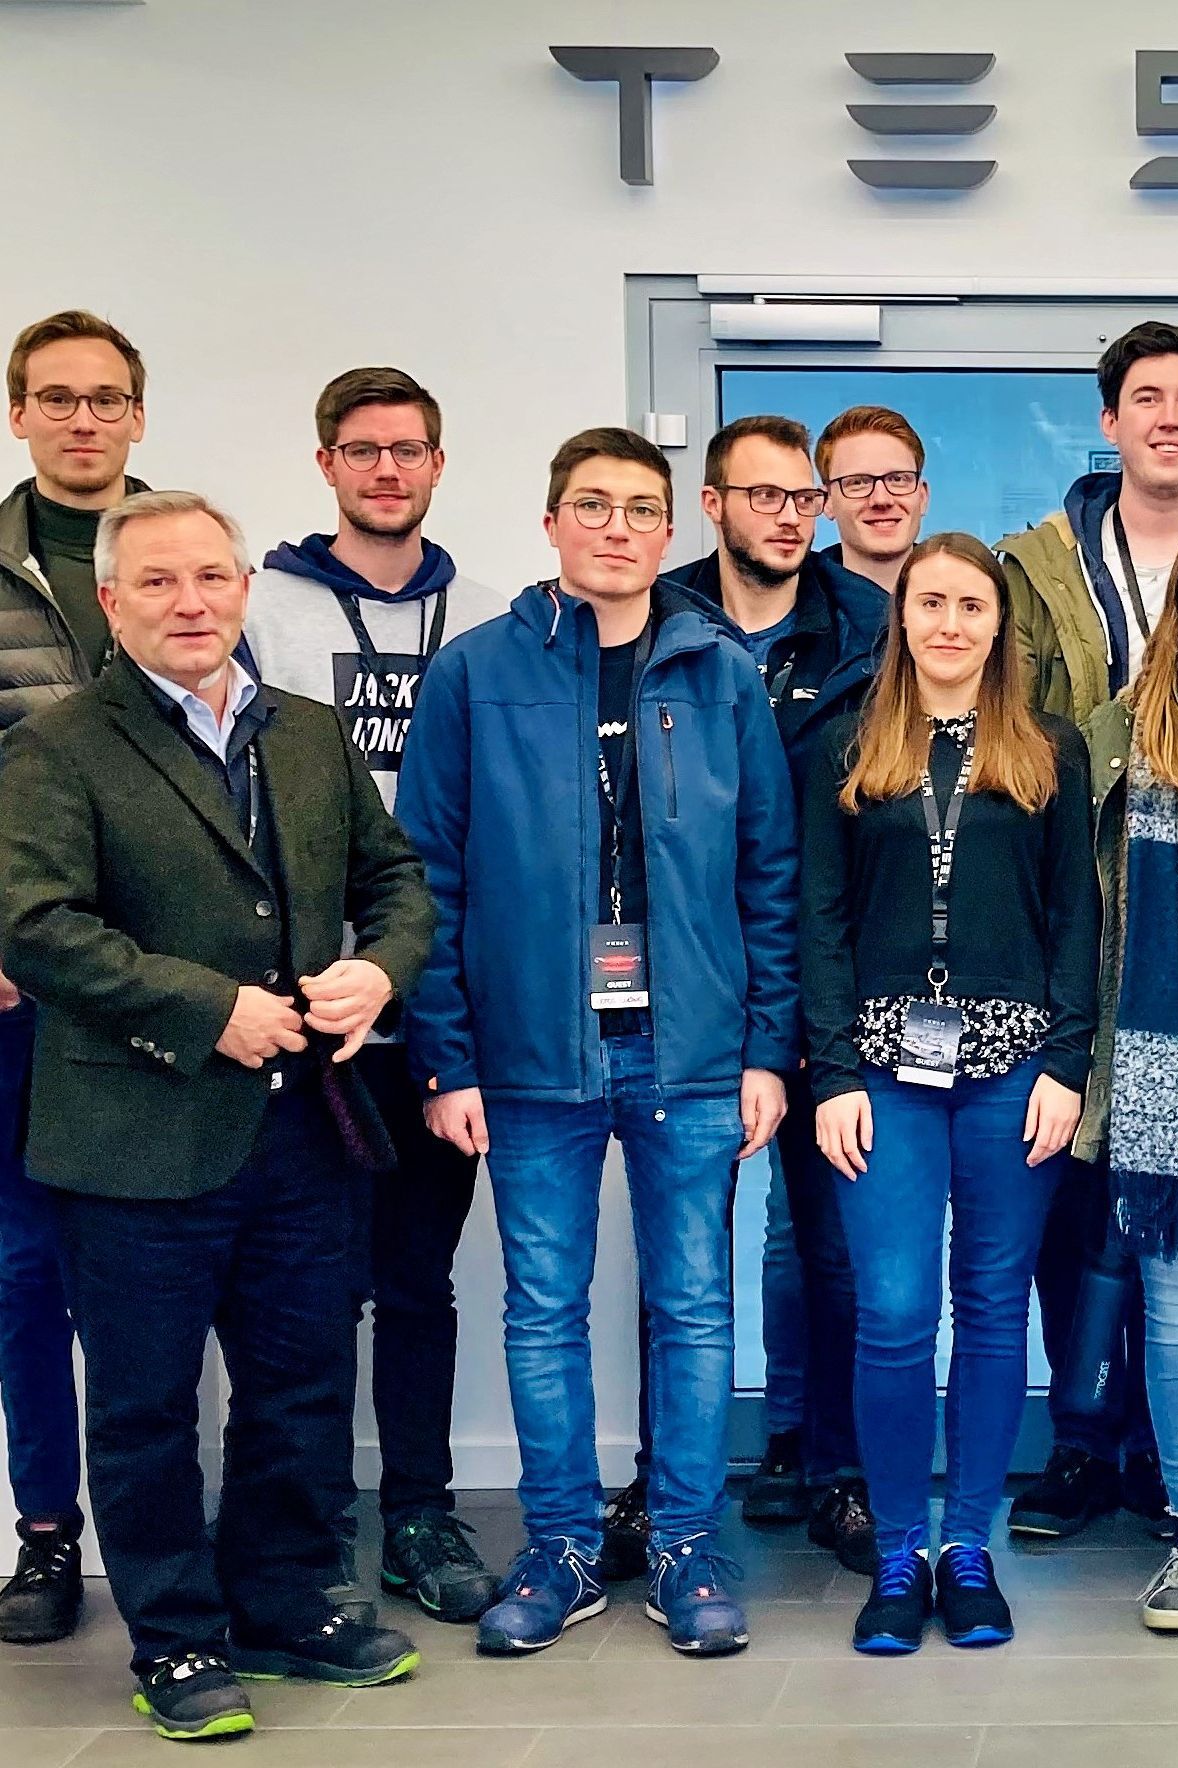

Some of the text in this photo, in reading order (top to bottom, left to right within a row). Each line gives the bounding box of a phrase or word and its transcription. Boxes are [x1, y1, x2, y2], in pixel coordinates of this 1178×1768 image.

[344, 672, 419, 708] JACK
[351, 716, 412, 752] JON
[953, 746, 976, 796] TESLA
[929, 831, 942, 885] TESL
[937, 829, 956, 887] TESLA
